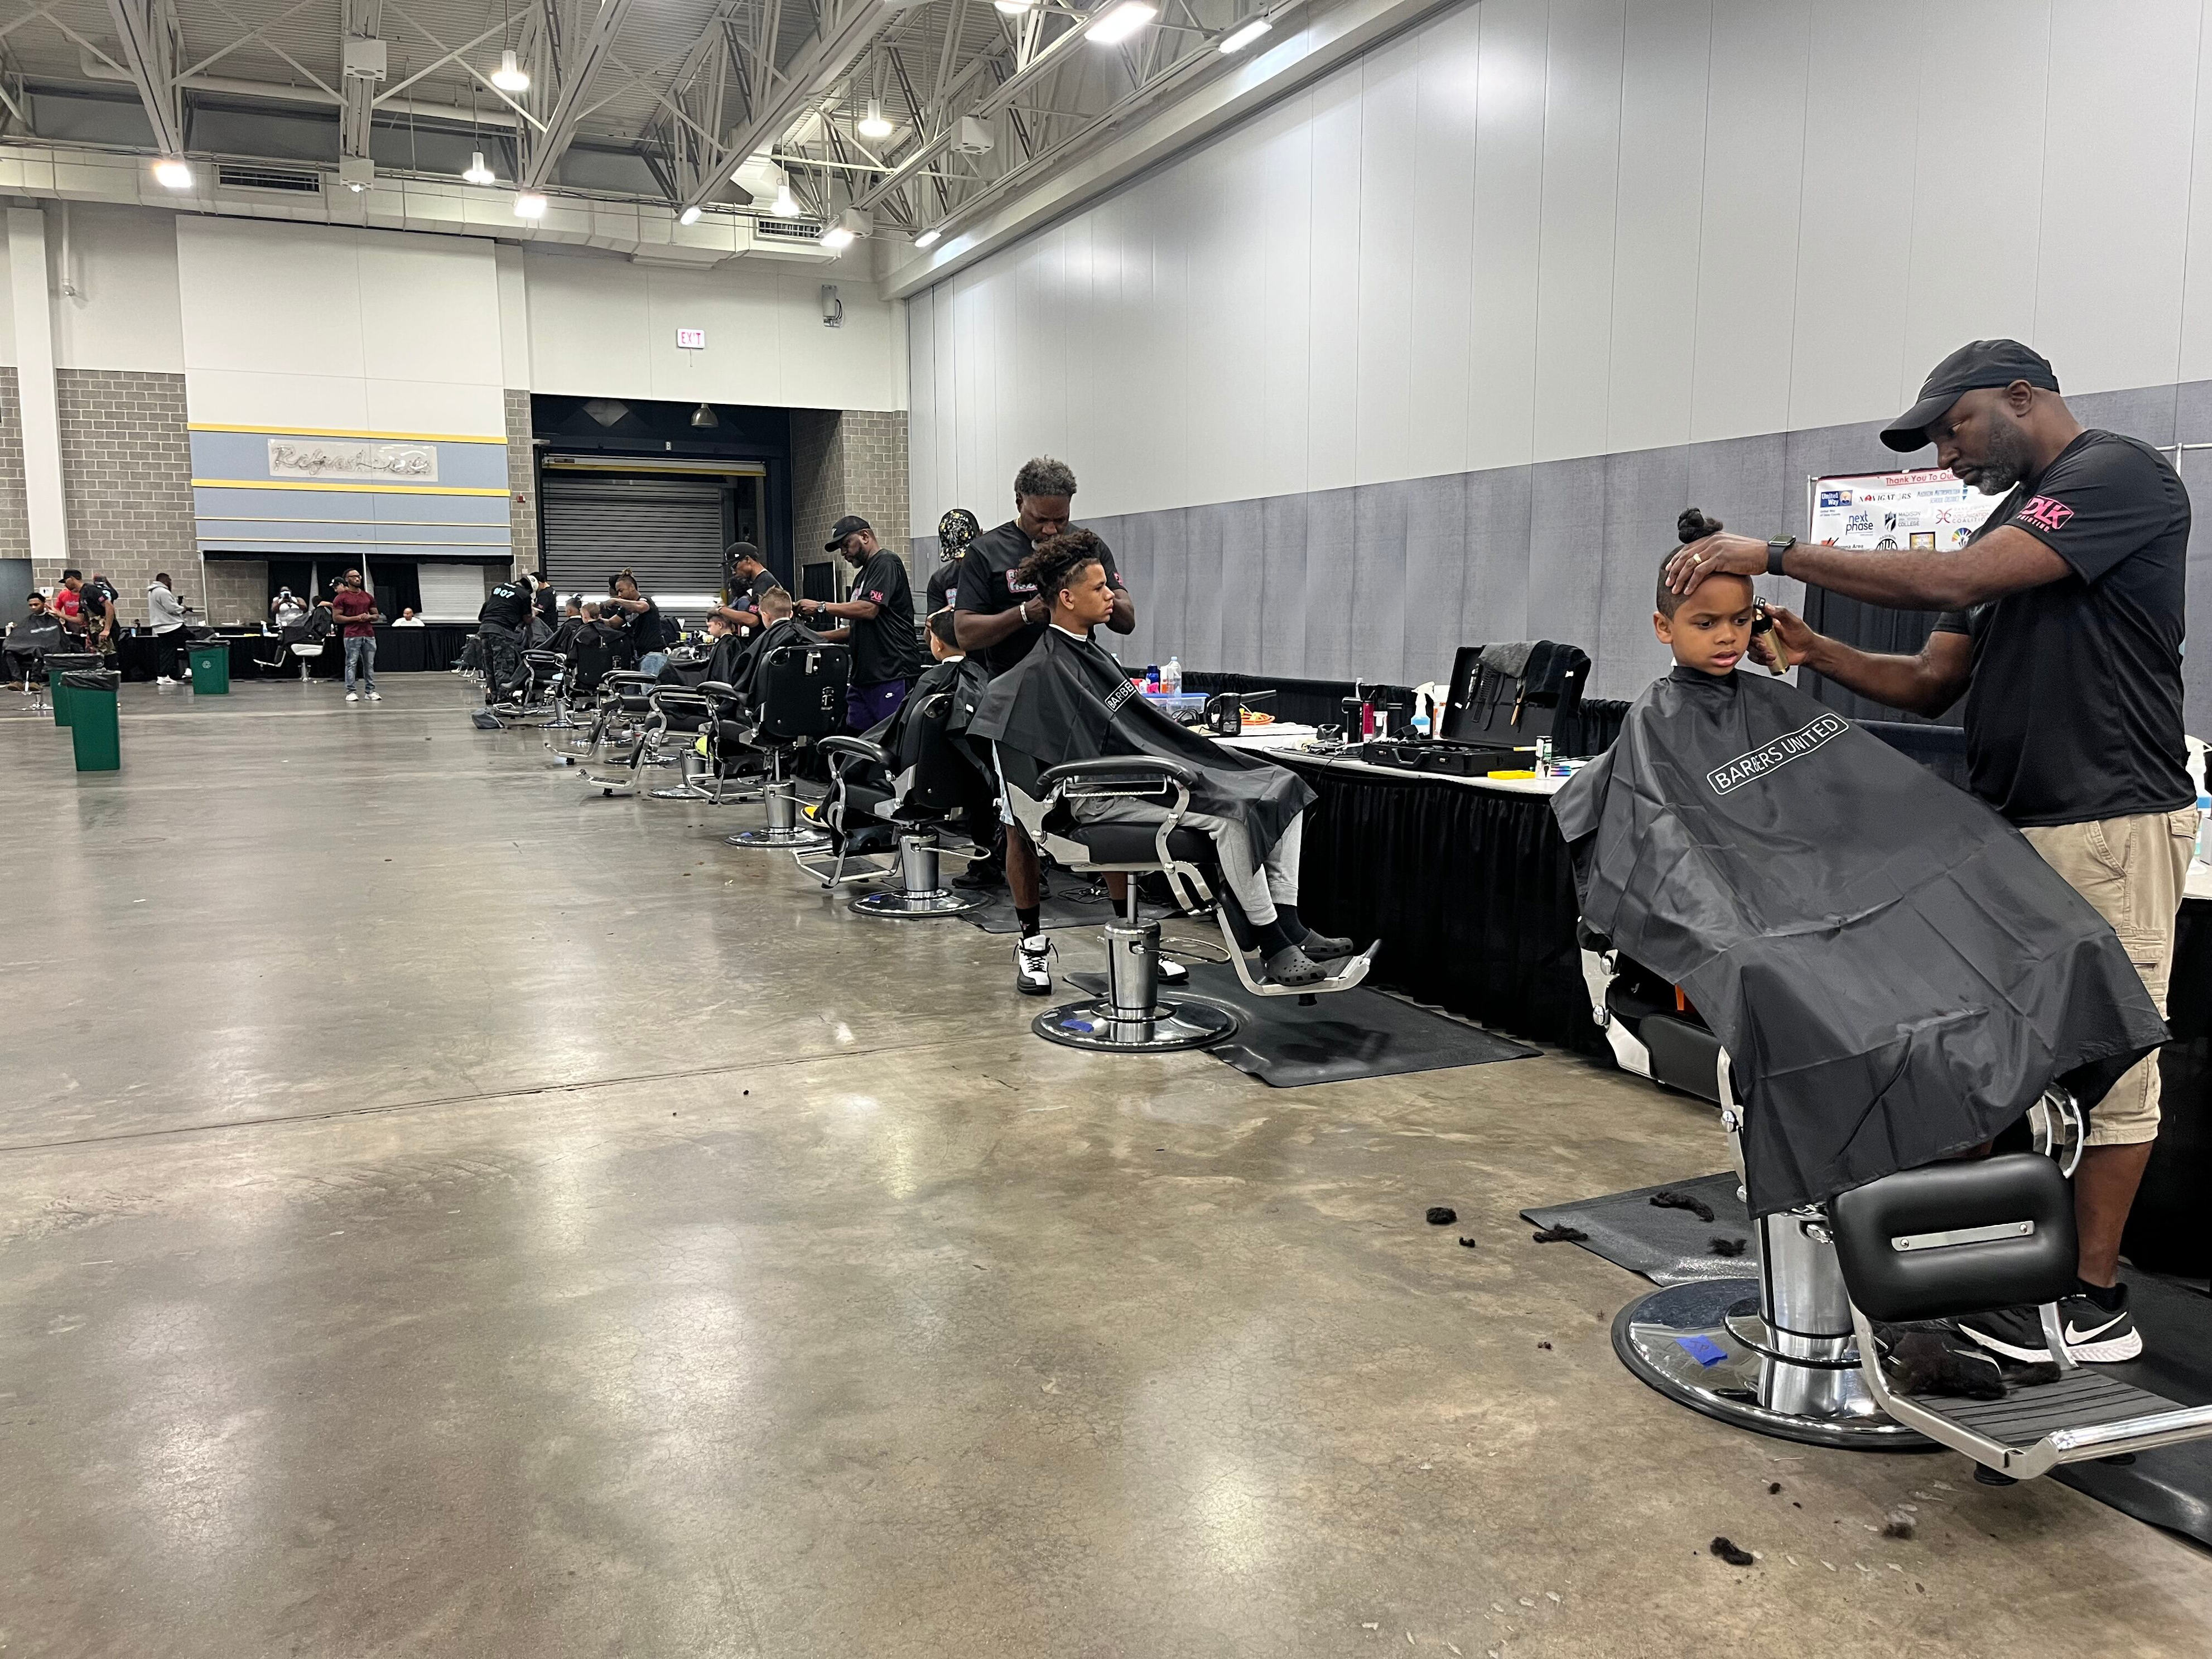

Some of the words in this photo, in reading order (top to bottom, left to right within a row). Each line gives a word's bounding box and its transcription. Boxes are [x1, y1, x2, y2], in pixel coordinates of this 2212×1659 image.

[681, 331, 701, 345] EXIT
[666, 441, 671, 450] B
[1859, 493, 1912, 503] NAVIGATRS
[1848, 510, 1868, 523] next
[2021, 497, 2073, 529] DLK
[1845, 522, 1873, 536] phase
[870, 590, 883, 600] DLK
[1107, 682, 1134, 709] BARBE
[1781, 719, 1838, 754] UNITED
